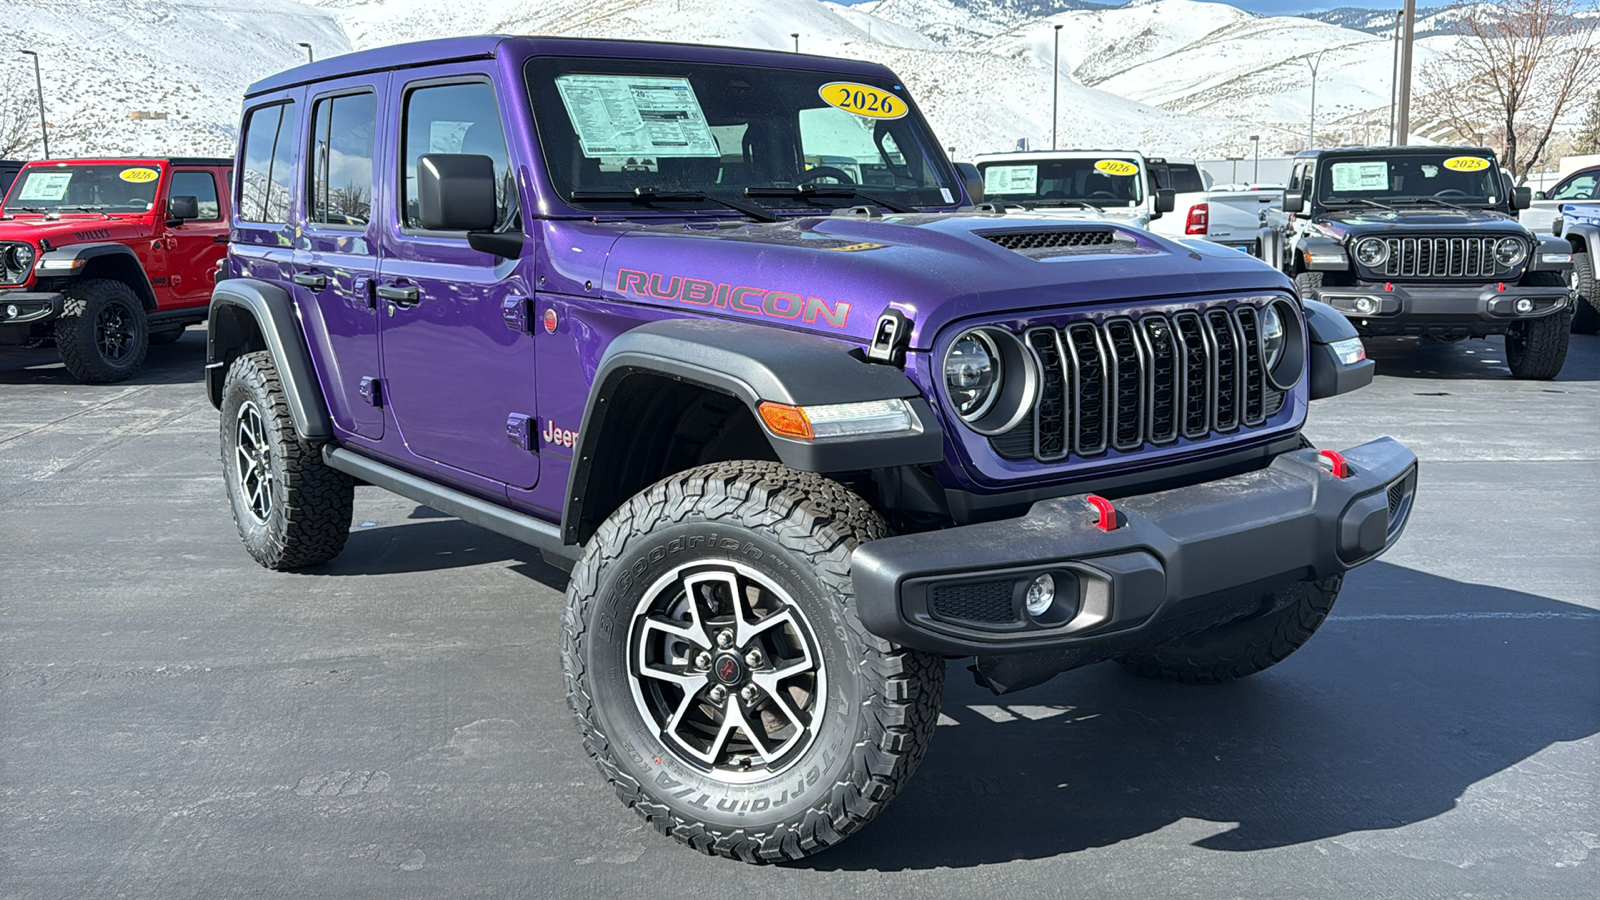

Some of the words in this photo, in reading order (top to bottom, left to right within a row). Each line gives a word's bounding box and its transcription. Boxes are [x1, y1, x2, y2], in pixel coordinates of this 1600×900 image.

[839, 88, 893, 113] 2026
[1101, 162, 1132, 173] 2026
[1452, 159, 1482, 168] 2025
[125, 171, 153, 180] 2026
[74, 229, 111, 241] WILLYS
[617, 268, 852, 329] RUBICON
[598, 533, 764, 643] BFGoodrich
